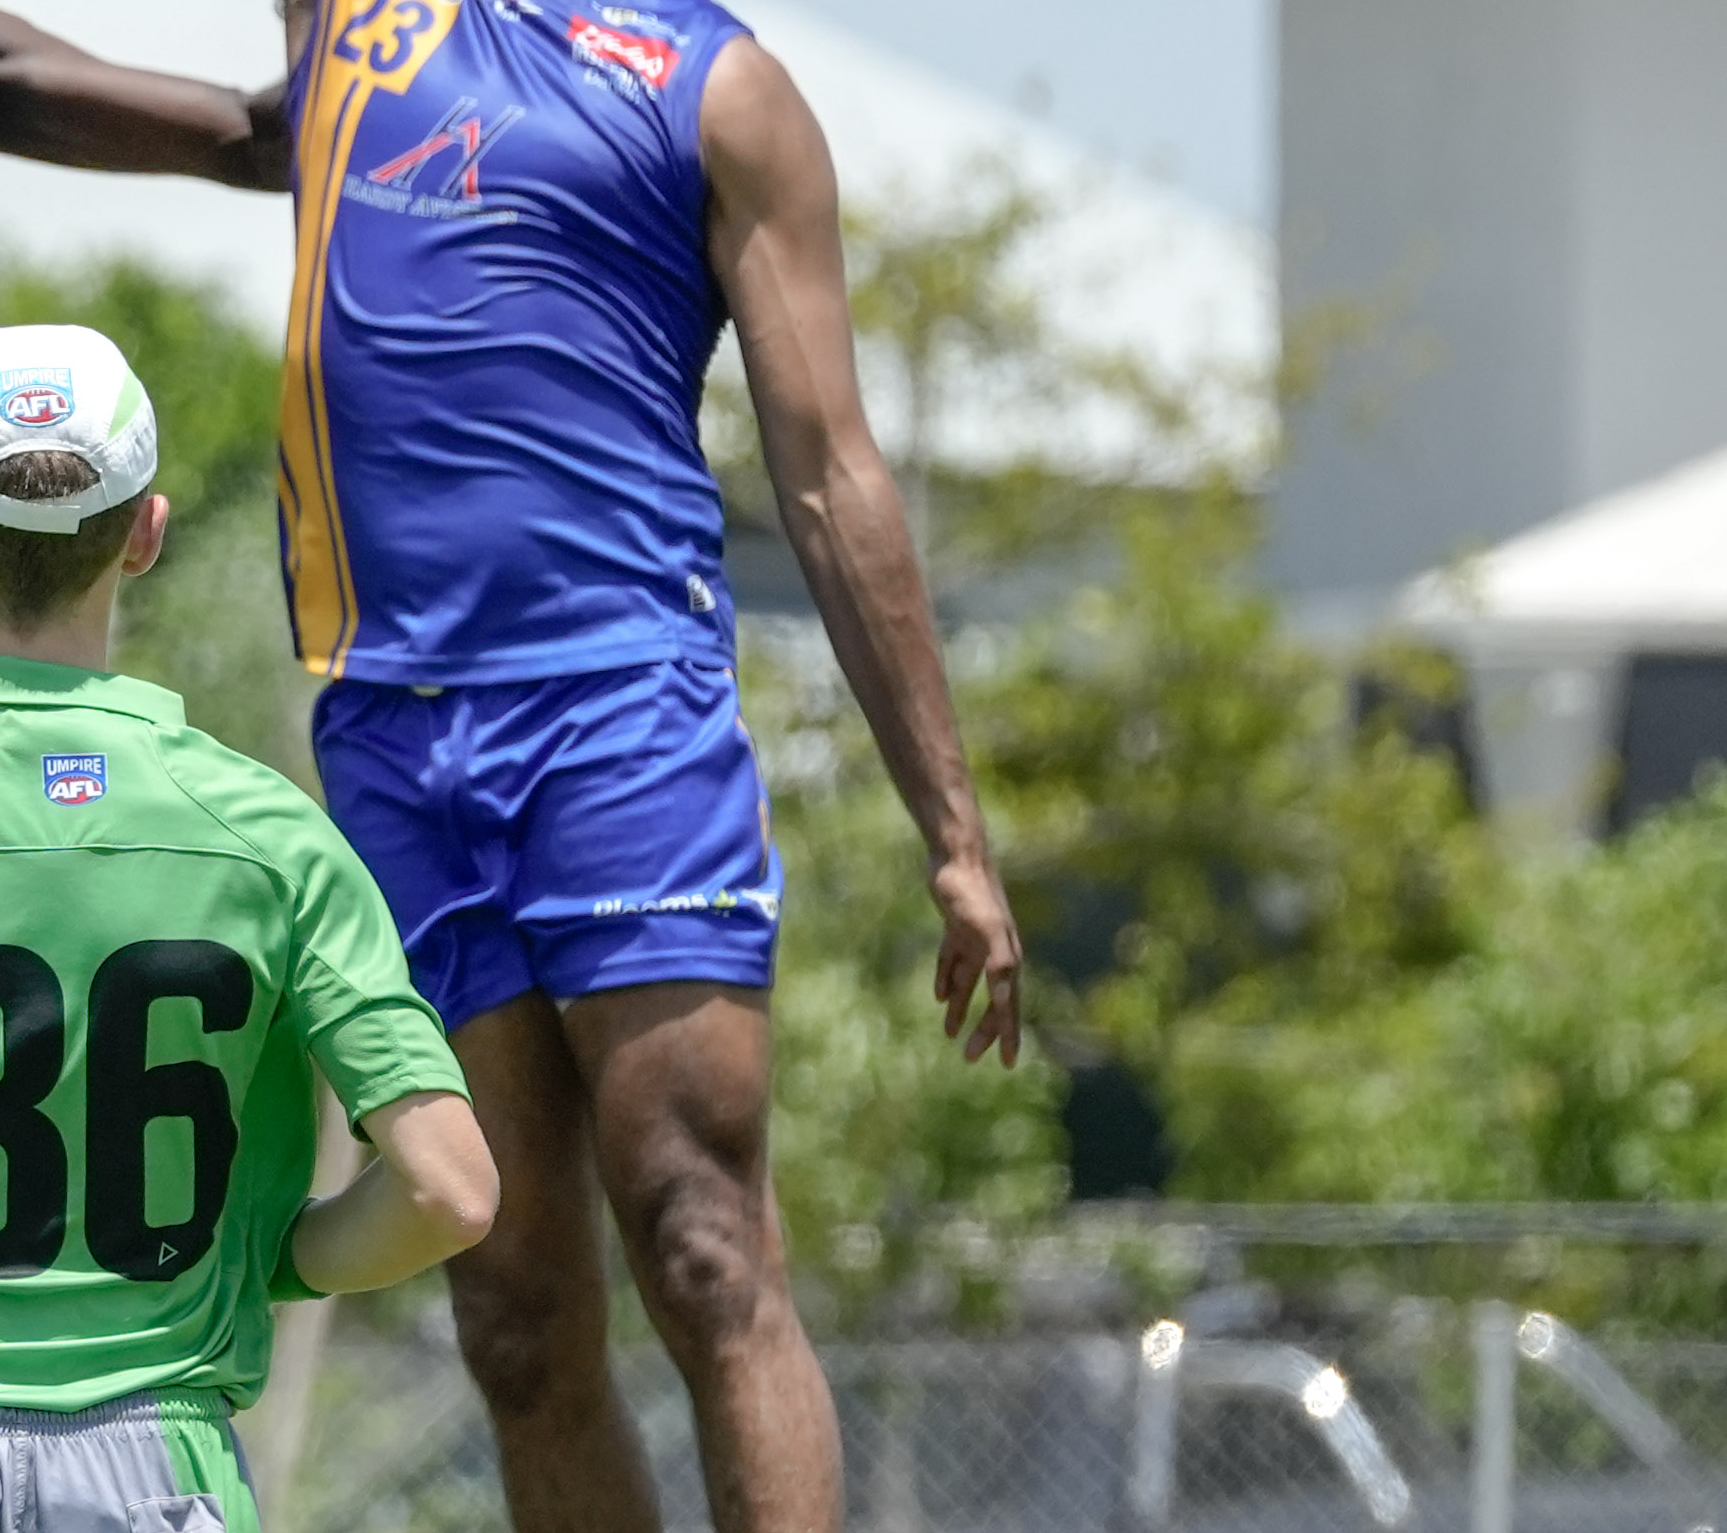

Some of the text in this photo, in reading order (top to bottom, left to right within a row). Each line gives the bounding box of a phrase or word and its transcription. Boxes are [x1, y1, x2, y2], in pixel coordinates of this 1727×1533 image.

[0, 368, 70, 390] UMPIRE
[8, 394, 71, 419] AFL
[46, 757, 102, 776] UMPIRE
[49, 780, 103, 799] AFL
